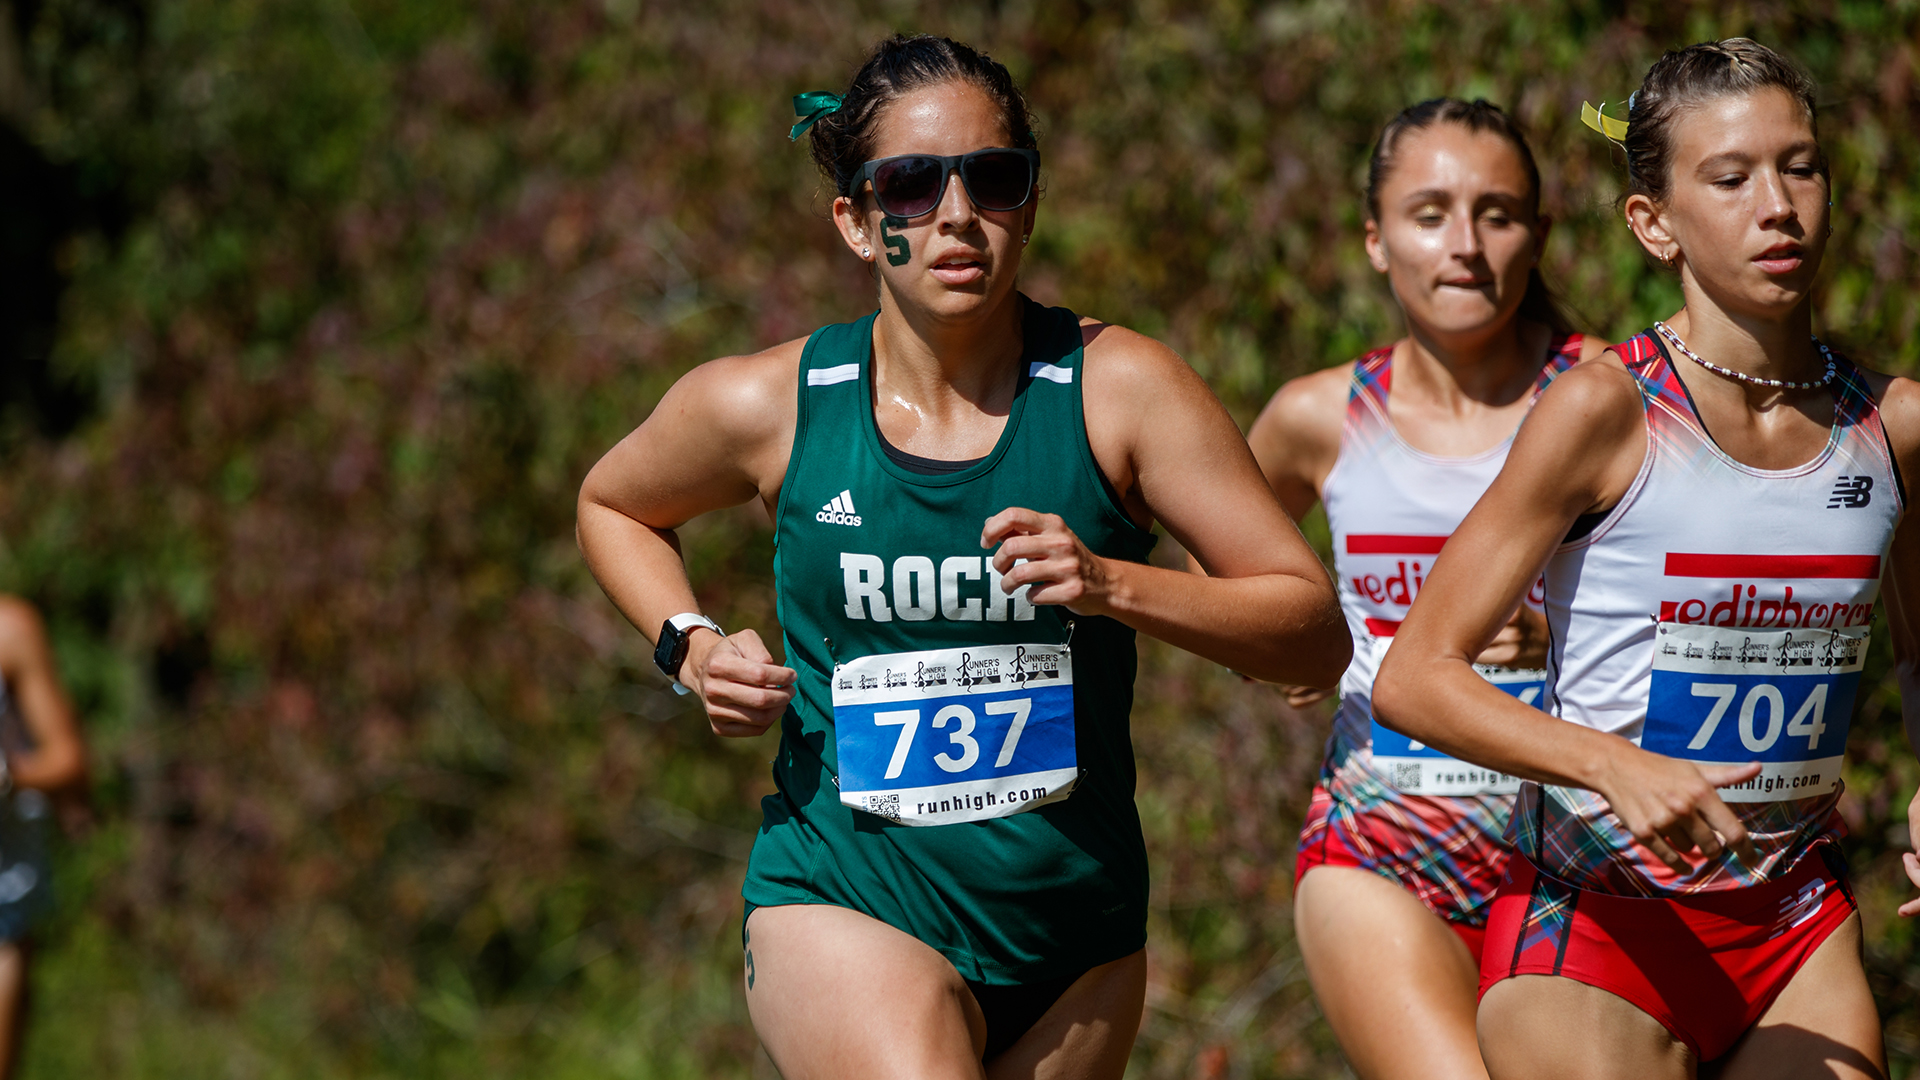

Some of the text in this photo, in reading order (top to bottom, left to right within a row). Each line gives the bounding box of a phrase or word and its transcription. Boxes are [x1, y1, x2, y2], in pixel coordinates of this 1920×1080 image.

[816, 511, 862, 527] adidas
[957, 652, 1000, 671] RUNNER'S
[1010, 646, 1058, 666] RUNNER'S
[1687, 683, 1829, 752] 704
[874, 698, 1032, 780] 737
[917, 786, 1048, 815] runhigh.com
